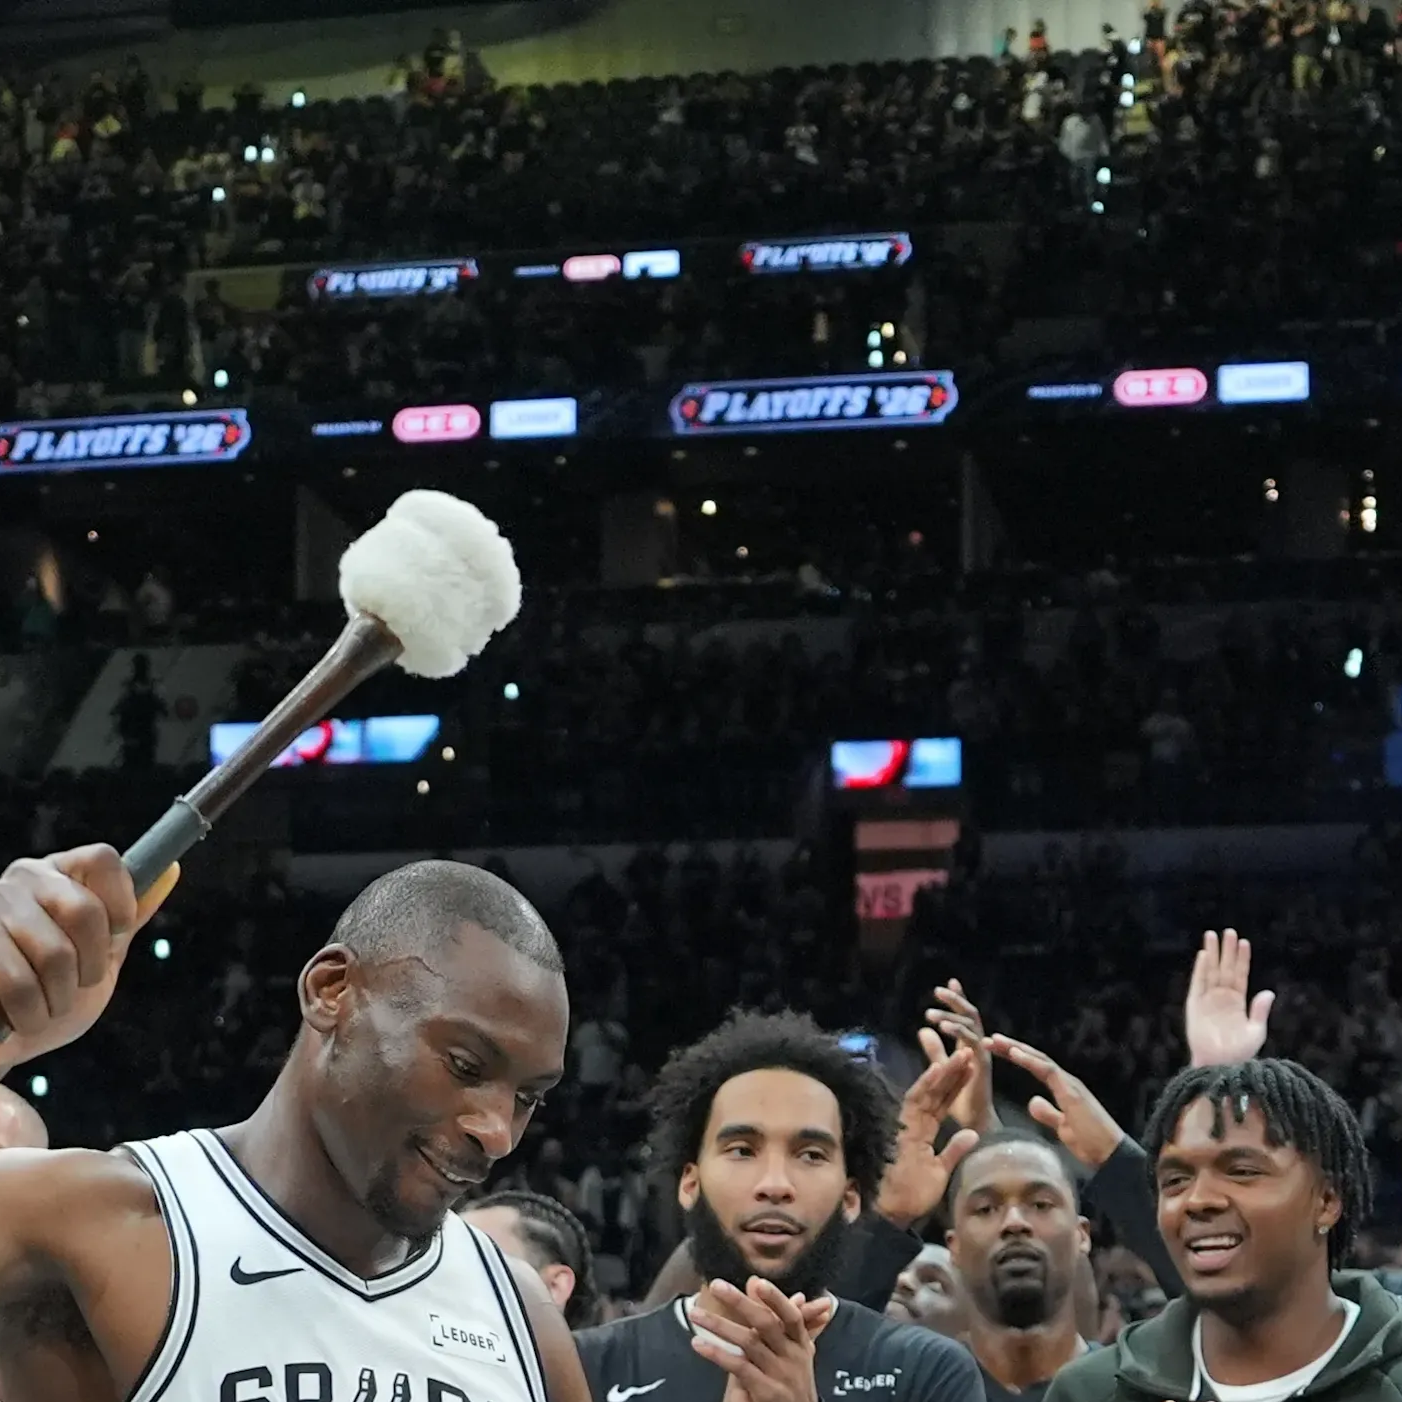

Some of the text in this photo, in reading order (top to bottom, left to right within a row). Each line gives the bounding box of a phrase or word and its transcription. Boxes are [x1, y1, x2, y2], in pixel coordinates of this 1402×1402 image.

[699, 387, 869, 421] PLAYOFFS
[9, 424, 170, 461] PLAYOFFS
[442, 1324, 496, 1351] LEDGER
